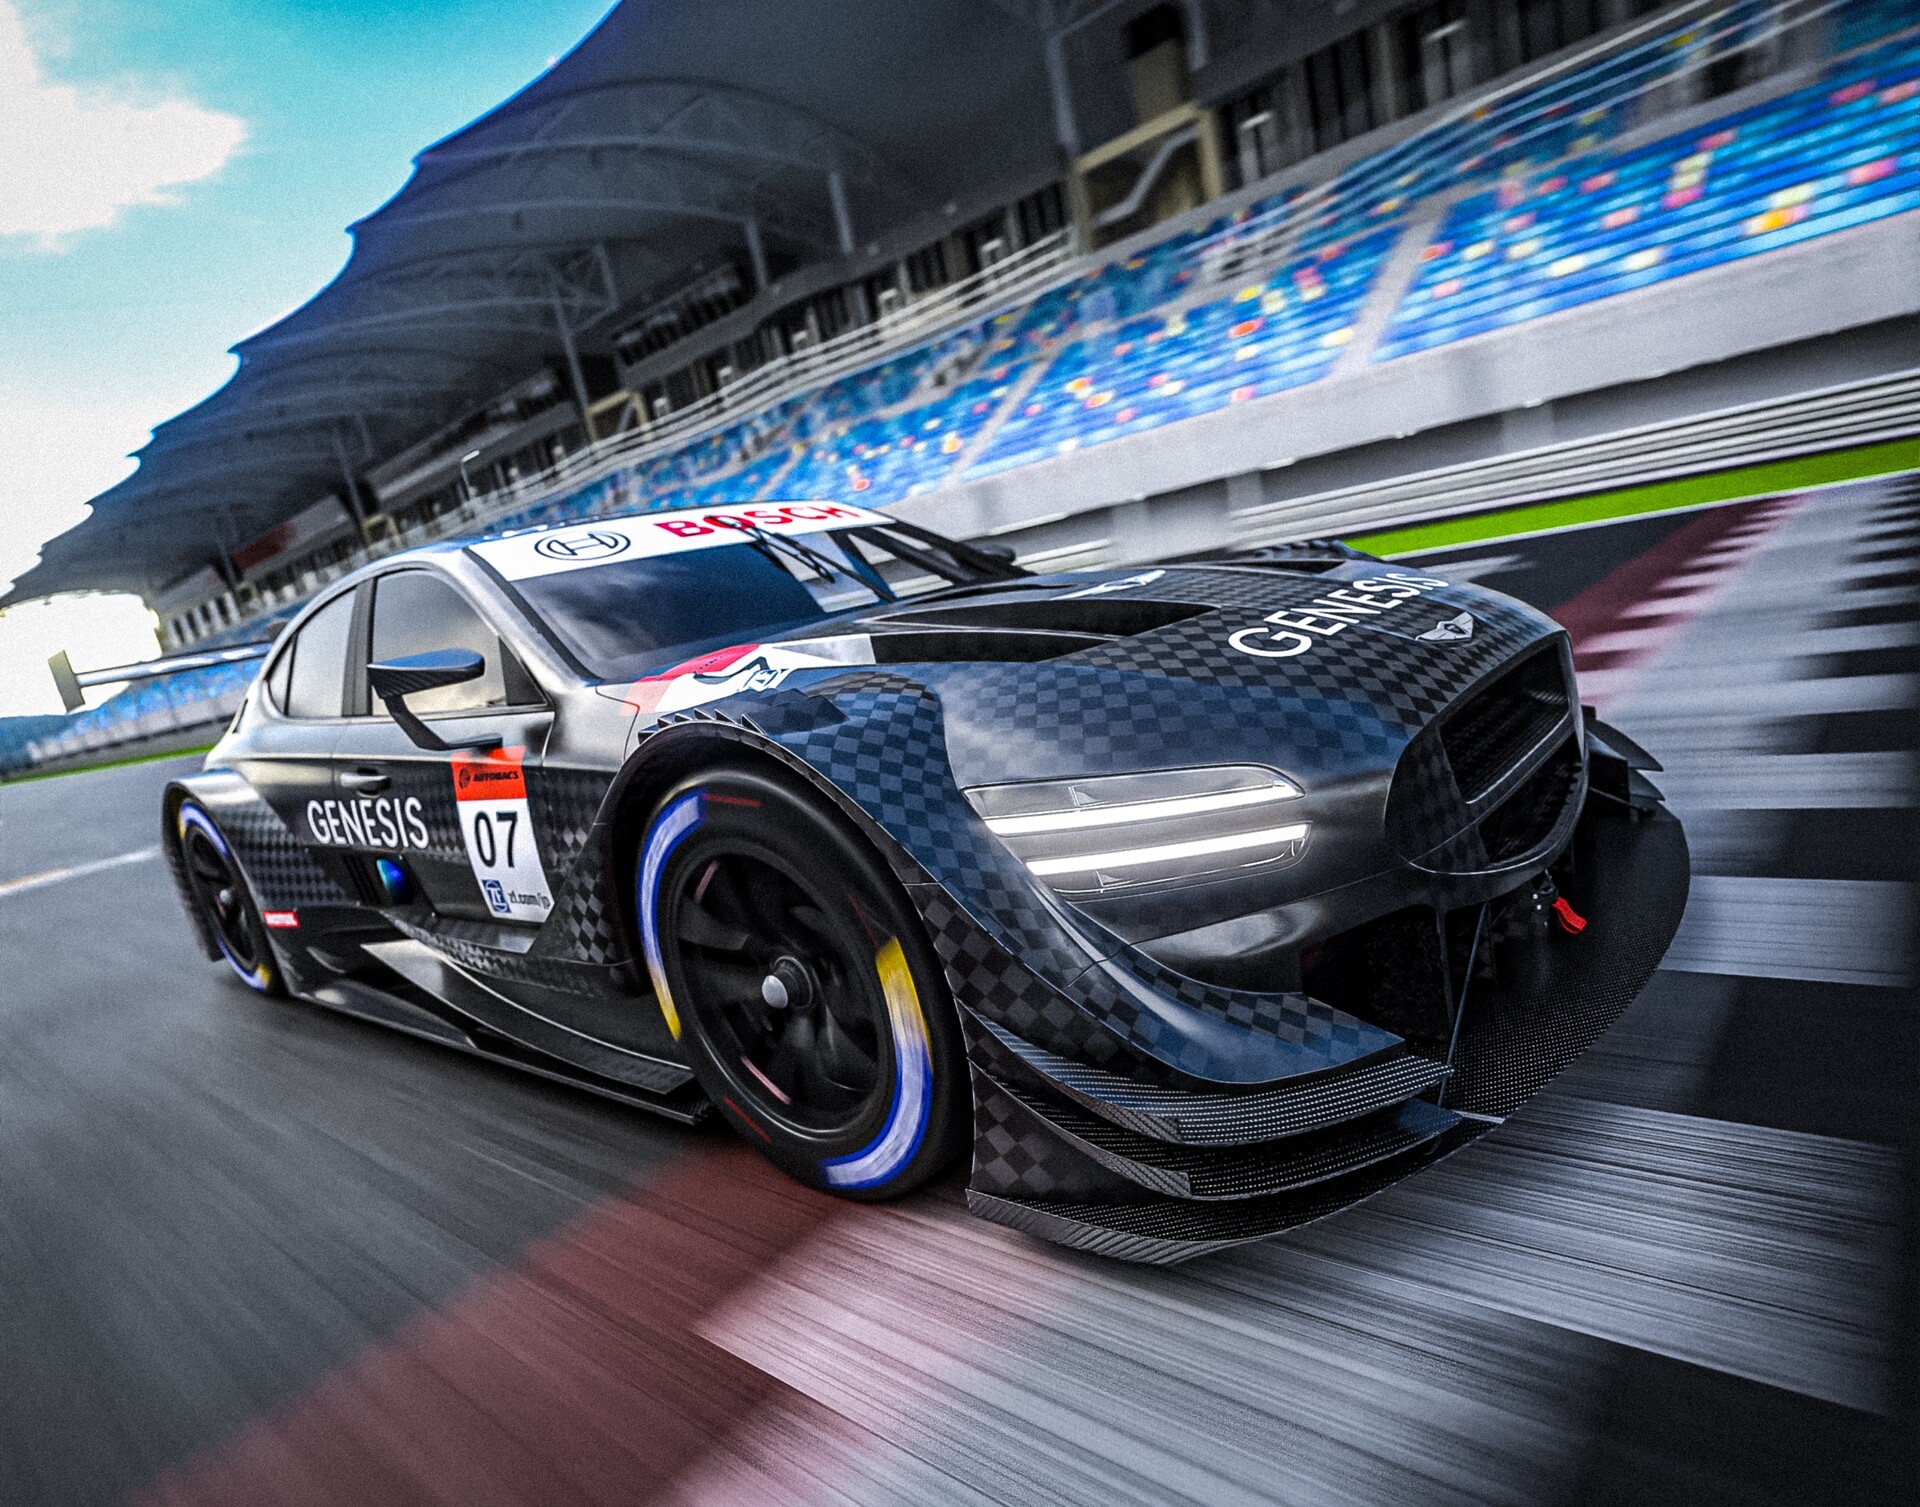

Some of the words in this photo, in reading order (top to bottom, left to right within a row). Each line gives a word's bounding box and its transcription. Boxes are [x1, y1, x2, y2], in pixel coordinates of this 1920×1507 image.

[653, 506, 861, 538] BOSCH
[1228, 572, 1450, 657] GENESIS
[307, 797, 429, 849] GENESIS
[474, 811, 518, 868] 07
